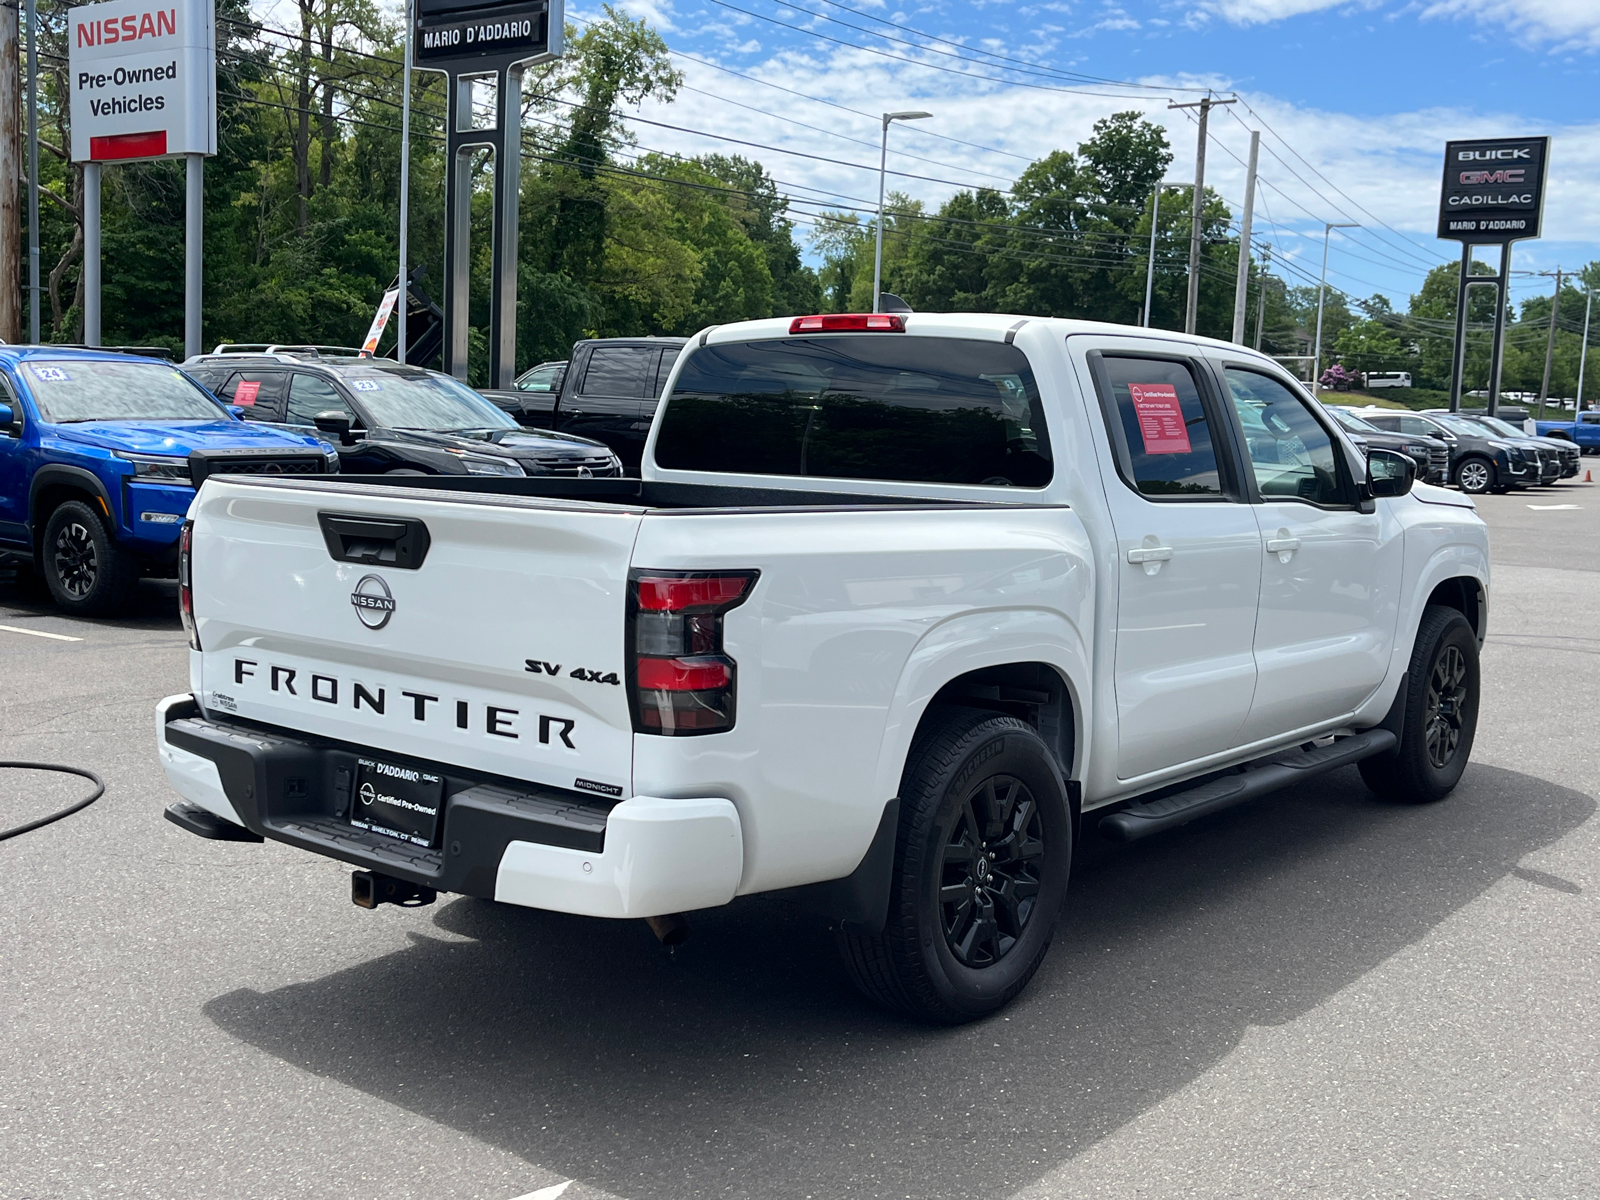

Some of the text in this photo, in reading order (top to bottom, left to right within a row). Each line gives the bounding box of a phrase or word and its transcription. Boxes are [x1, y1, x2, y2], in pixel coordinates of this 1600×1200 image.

[77, 9, 176, 48] NISSAN
[424, 20, 531, 49] MARIO D'ADDARIO
[78, 61, 177, 90] Pre-Owned
[90, 94, 165, 117] Vehicles
[1458, 148, 1531, 161] BUICK
[1460, 169, 1525, 184] GMC
[1448, 194, 1532, 205] CADILLAC
[1449, 220, 1526, 231] MARIO D'ADDARIO
[351, 594, 393, 610] NISSAN
[525, 659, 562, 676] SV
[234, 658, 577, 750] FRONTIER
[376, 763, 419, 782] D'ADDARIO
[954, 740, 1004, 793] MICHELIN
[576, 780, 619, 794] MIDNIGHT
[377, 793, 437, 816] Certified Pre-Owned
[371, 824, 400, 839] SHELTON,
[400, 832, 409, 841] CT
